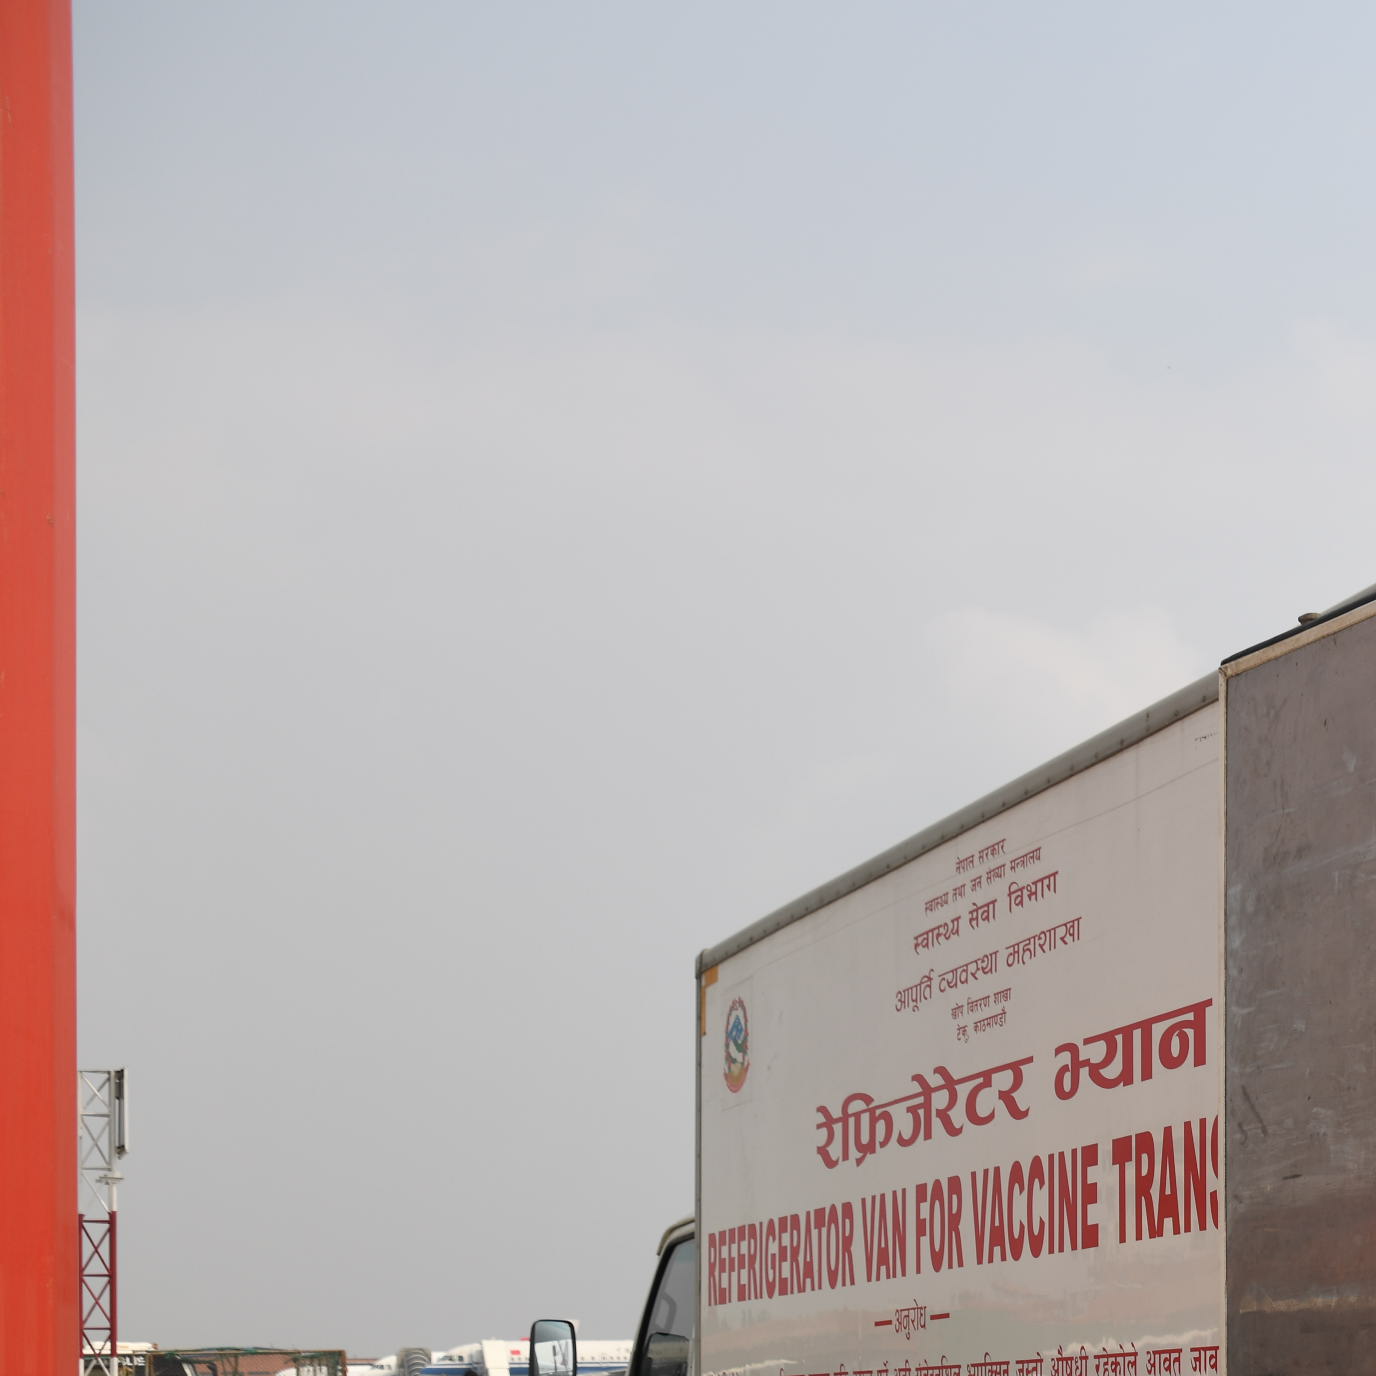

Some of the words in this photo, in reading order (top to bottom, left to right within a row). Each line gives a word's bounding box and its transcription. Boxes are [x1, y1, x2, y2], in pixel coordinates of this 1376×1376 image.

[952, 883, 967, 903] तथा
[955, 855, 974, 875] नेपाल
[978, 838, 1007, 864] सरकार
[913, 915, 961, 956] स्वास्थ्य
[968, 898, 998, 931] सेवा
[1007, 871, 1059, 913] विभाग
[895, 968, 935, 1013] आपूर्ति
[938, 950, 999, 993] व्यवस्था
[1005, 916, 1082, 968] महाशाखा
[815, 1055, 1034, 1169] रेफ्रिजेरेटर
[1054, 998, 1213, 1102] भ्यान
[708, 1201, 855, 1306] REFERIGERATOR
[861, 1187, 907, 1282] VAN
[916, 1175, 964, 1274] FOR
[972, 1143, 1099, 1266] VACCINE
[894, 1300, 927, 1340] अनुरोध
